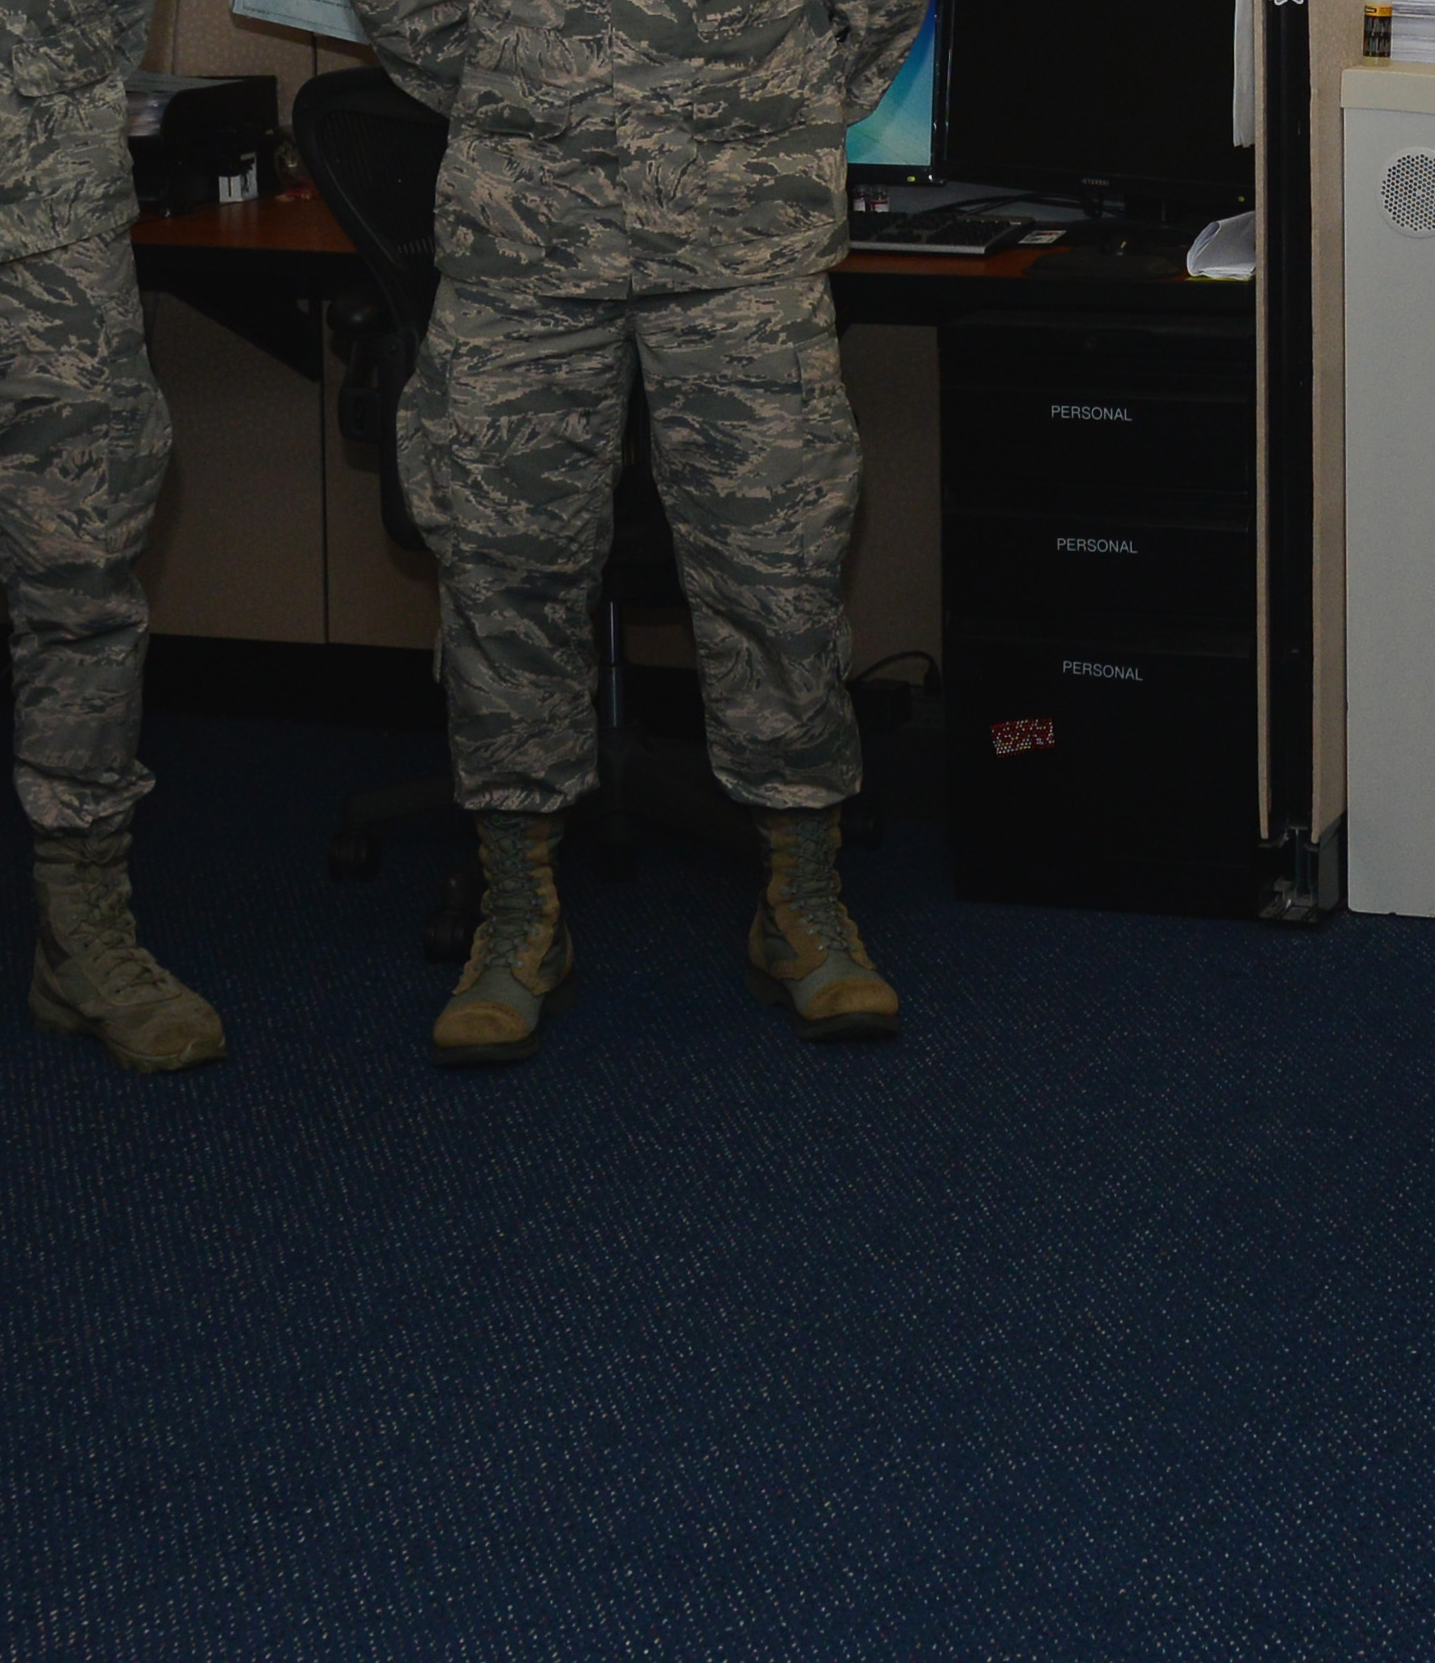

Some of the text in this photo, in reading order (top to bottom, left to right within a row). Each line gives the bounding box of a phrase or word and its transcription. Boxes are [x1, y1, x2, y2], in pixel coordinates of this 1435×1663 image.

[1051, 405, 1133, 422] PERSONAL
[1056, 537, 1139, 554] PERSONAL
[1062, 660, 1144, 681] PERSONAL
